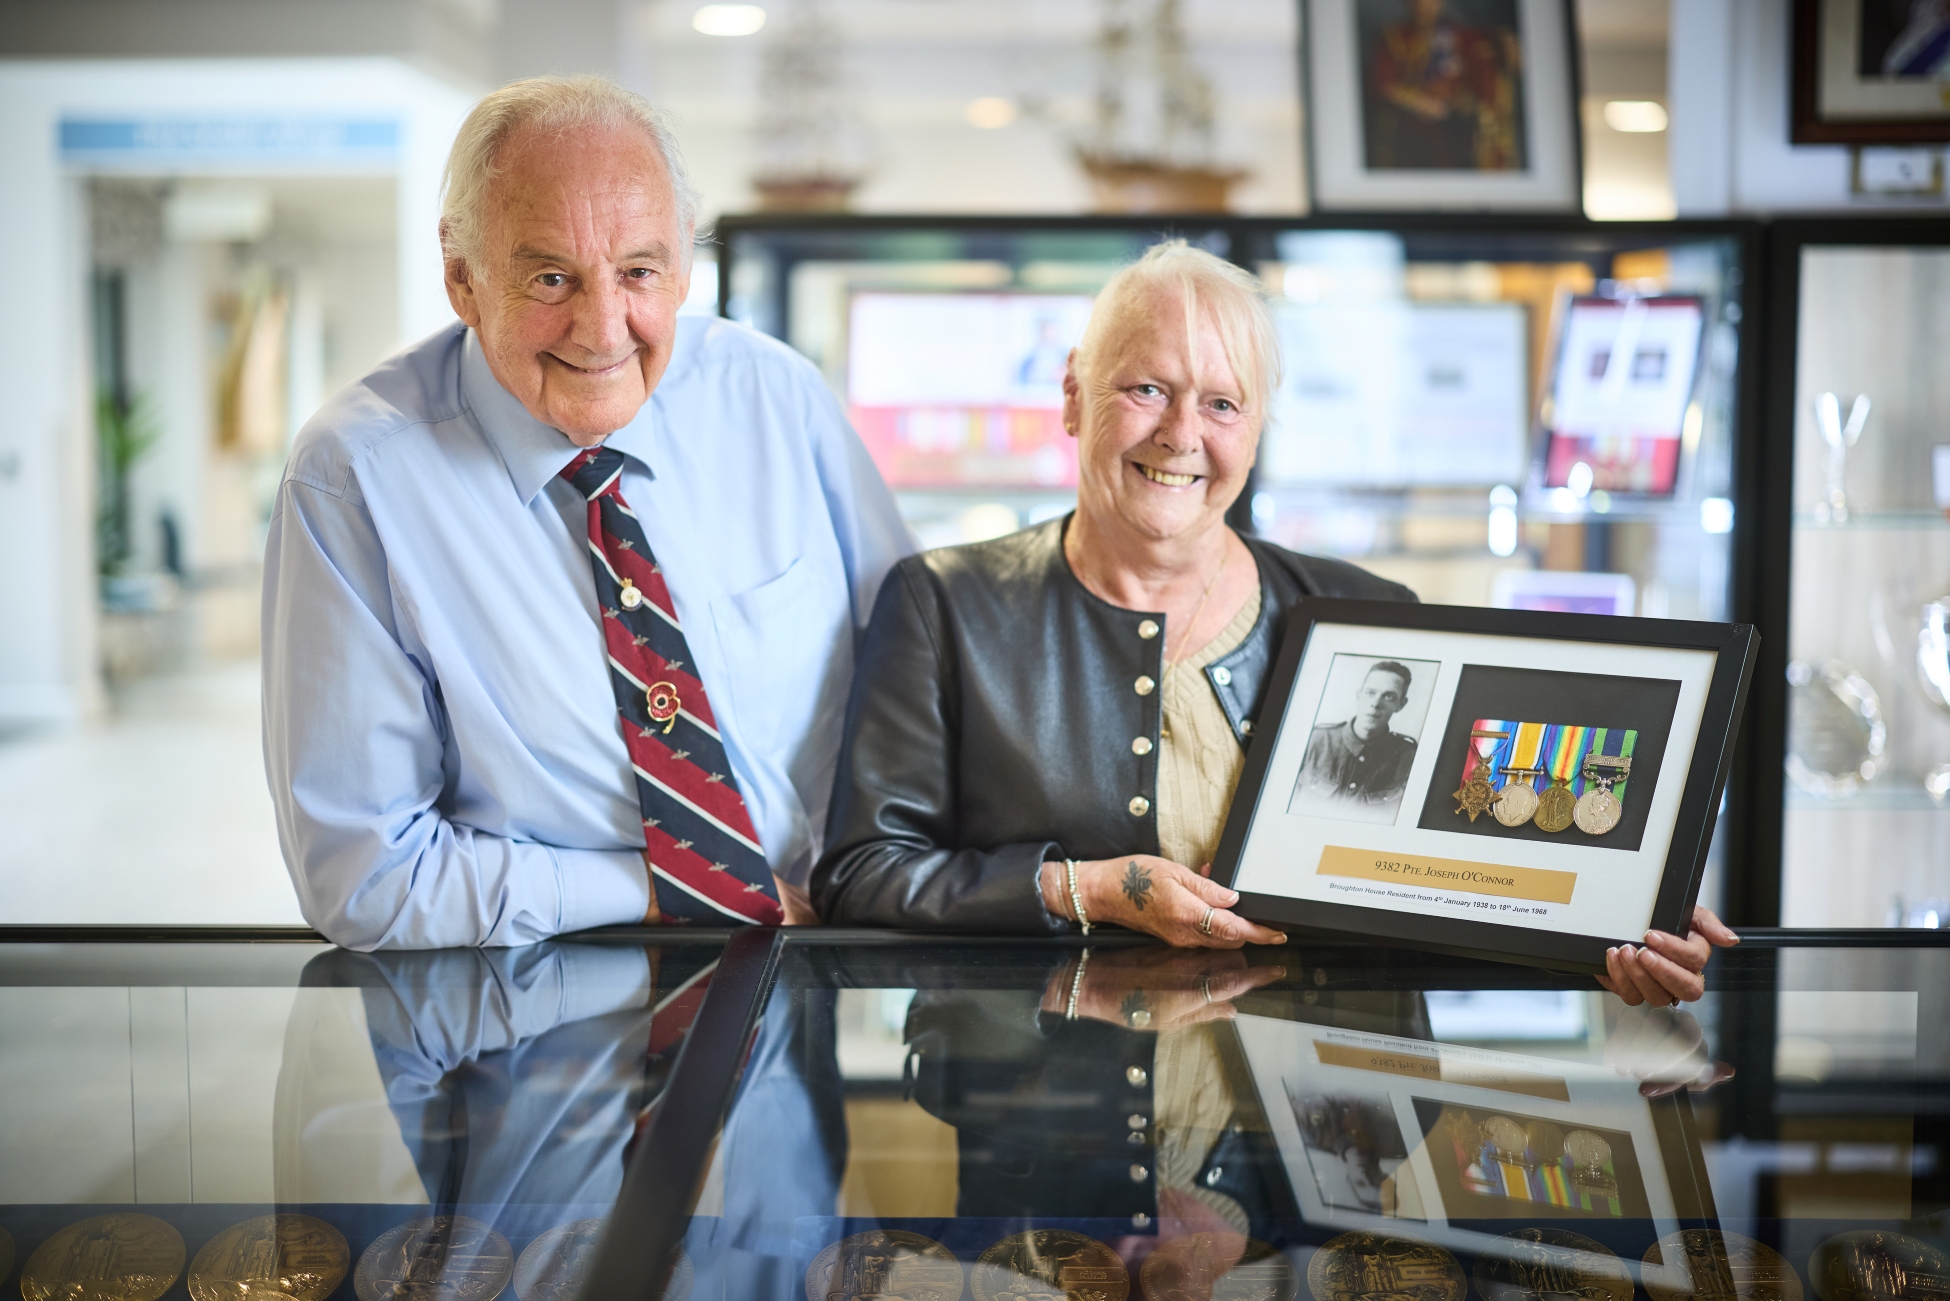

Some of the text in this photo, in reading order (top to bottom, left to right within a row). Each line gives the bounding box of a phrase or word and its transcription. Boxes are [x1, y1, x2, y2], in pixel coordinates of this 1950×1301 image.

[1375, 860, 1401, 873] 9382
[1329, 882, 1364, 894] Broughton
[1365, 887, 1386, 896] House
[1386, 890, 1416, 900] Resident
[1416, 893, 1433, 902] from
[1443, 897, 1472, 909] January
[1473, 901, 1489, 910] 1938
[1499, 904, 1512, 912] 18th
[1512, 906, 1530, 914] June
[1531, 908, 1548, 916] 1968
